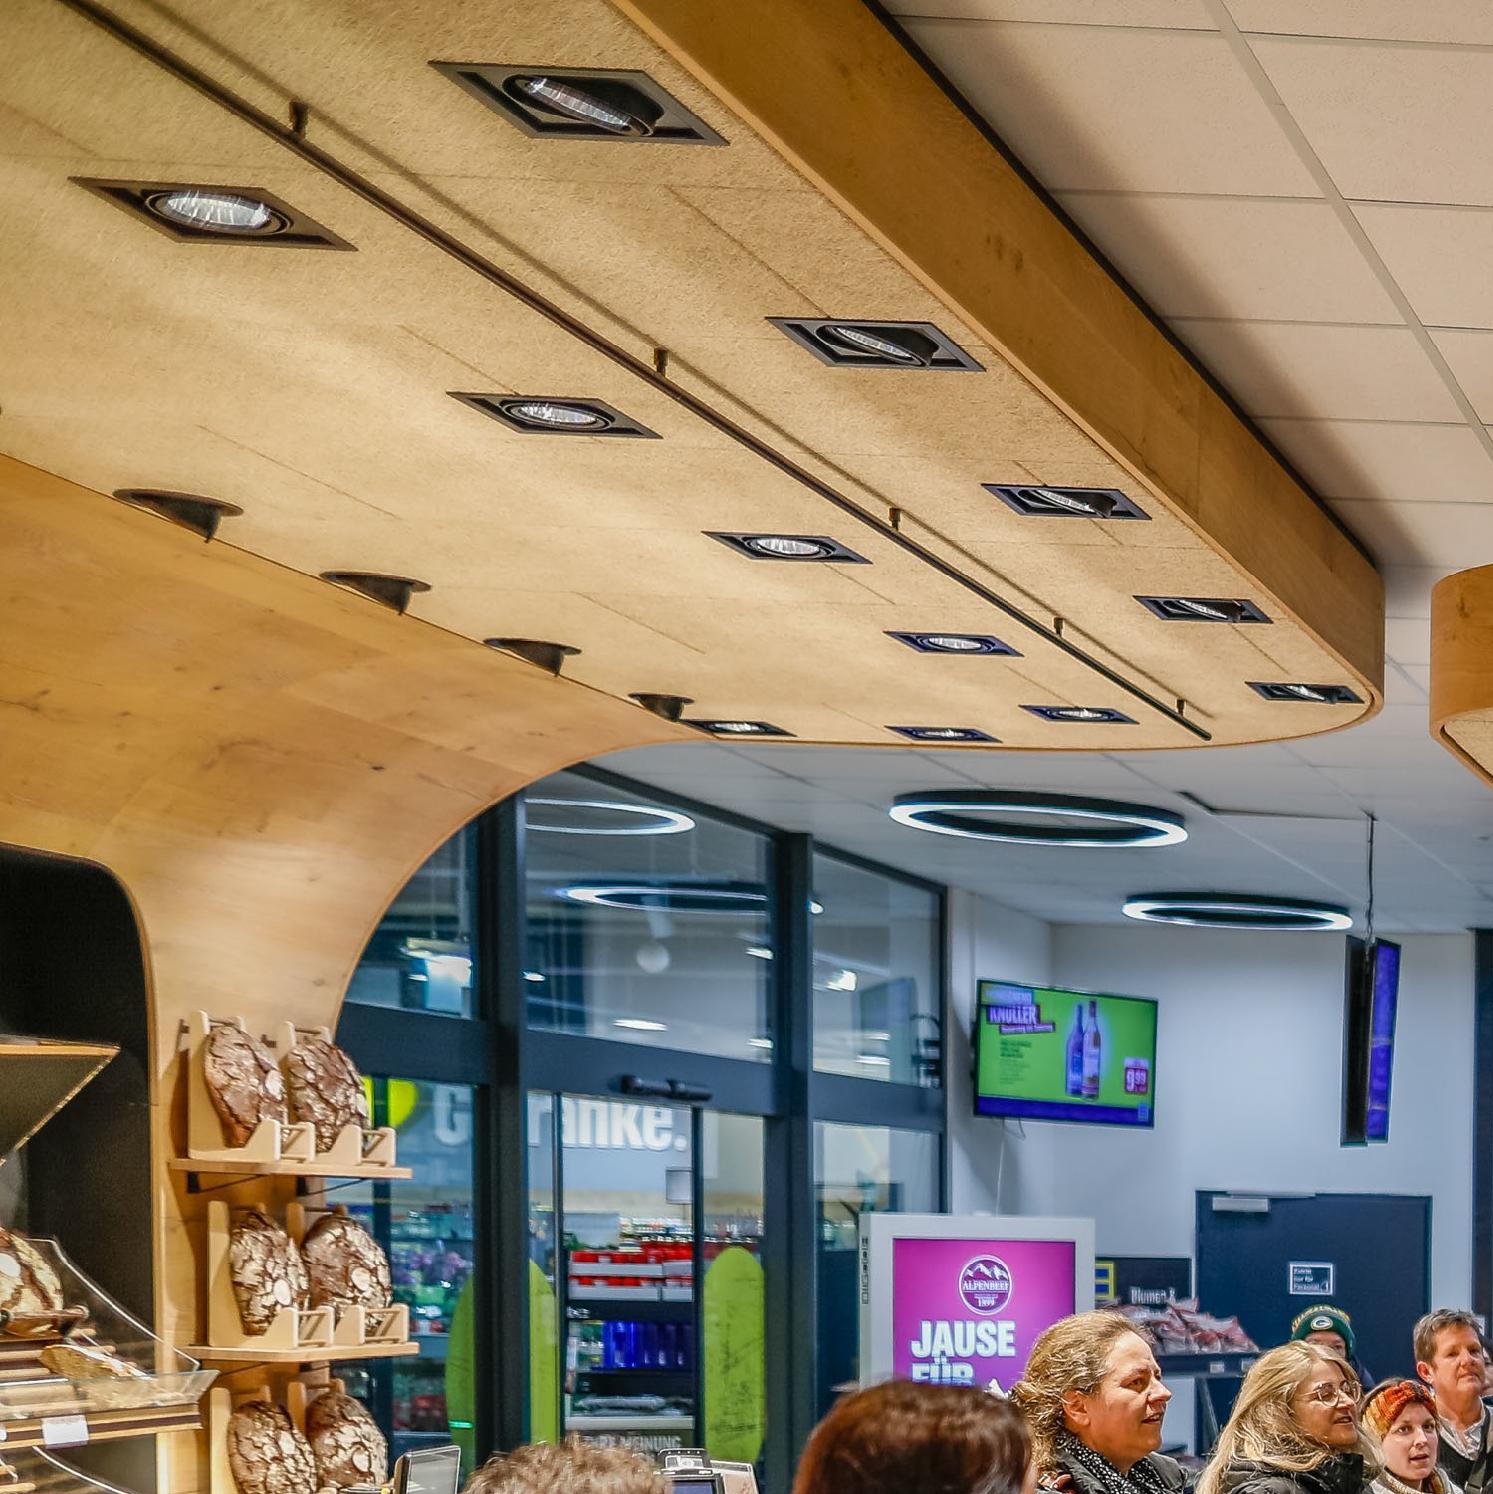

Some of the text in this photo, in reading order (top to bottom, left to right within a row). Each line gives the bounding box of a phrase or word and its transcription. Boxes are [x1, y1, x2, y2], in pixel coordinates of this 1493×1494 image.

[1130, 1287, 1167, 1305] Blumen
[911, 1320, 1016, 1358] JAUSE
[912, 1356, 974, 1386] FÜR
